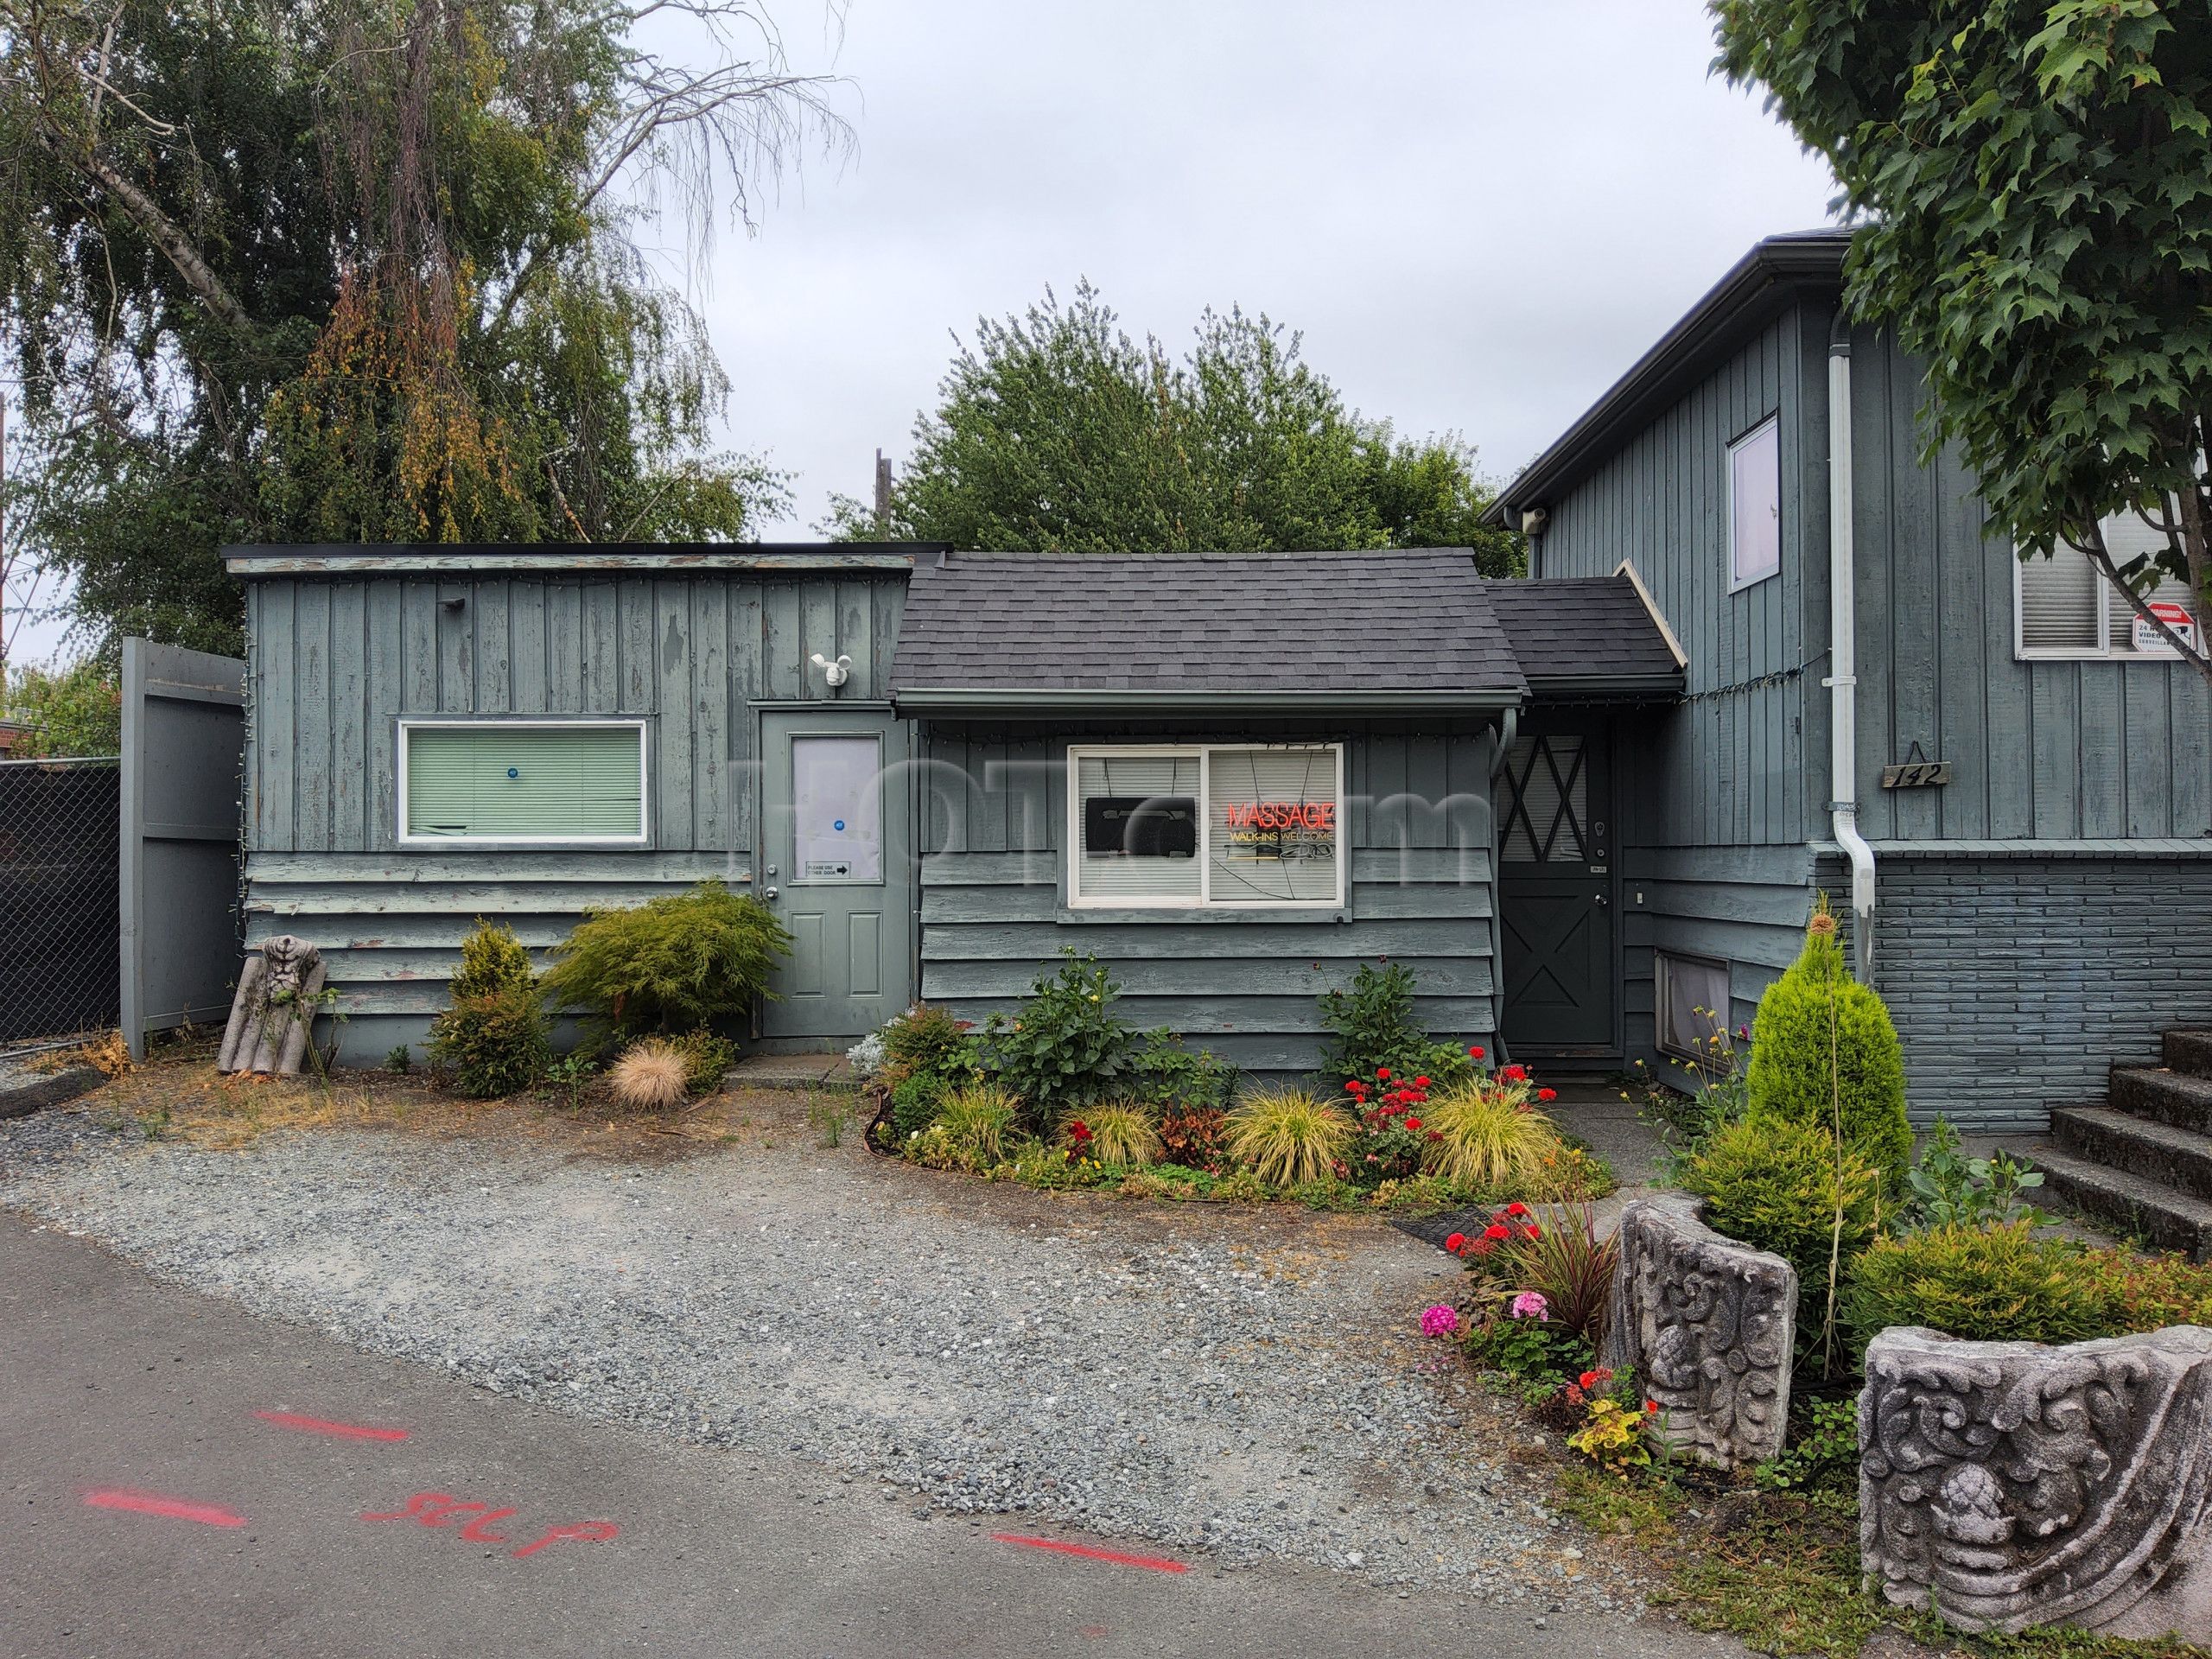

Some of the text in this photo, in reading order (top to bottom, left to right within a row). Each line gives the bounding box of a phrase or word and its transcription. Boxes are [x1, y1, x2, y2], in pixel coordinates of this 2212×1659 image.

[1892, 764, 1942, 786] 142
[1229, 802, 1335, 830] MASSAGE
[1230, 831, 1334, 842] WALK-INS WELCOME
